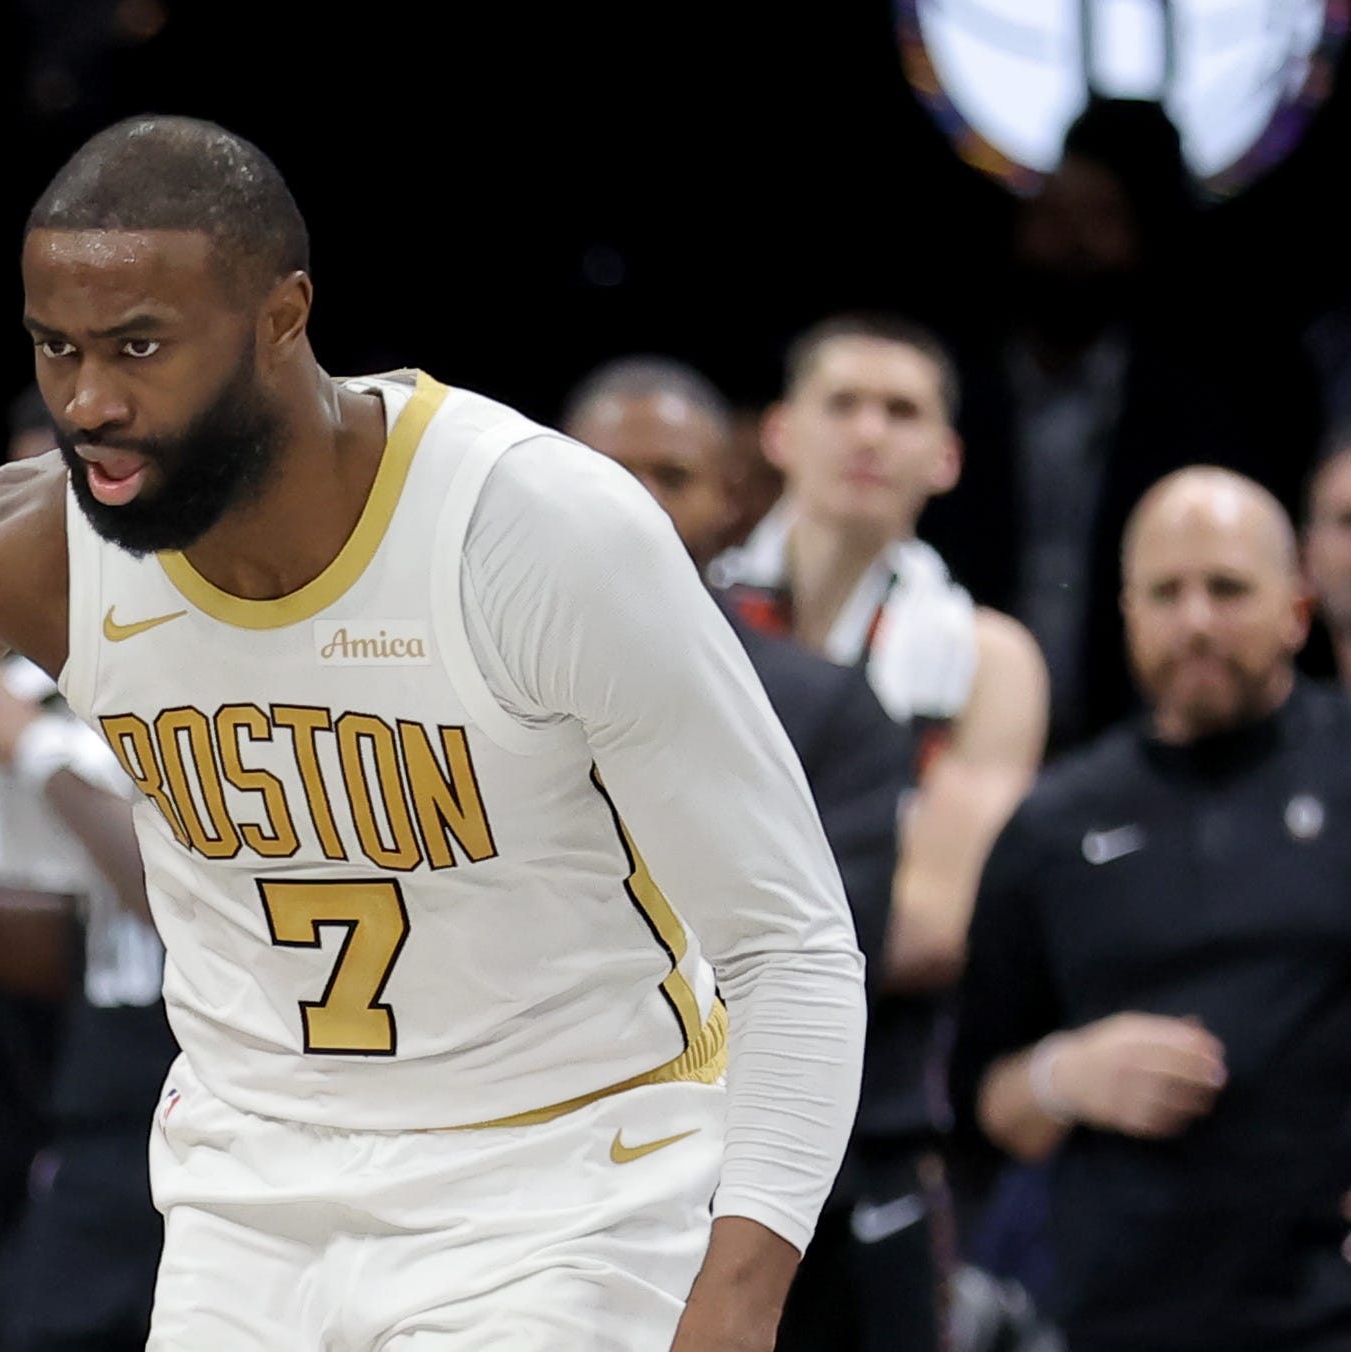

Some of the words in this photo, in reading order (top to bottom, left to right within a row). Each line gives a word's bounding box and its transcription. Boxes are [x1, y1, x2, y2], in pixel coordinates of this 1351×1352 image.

[320, 628, 426, 660] Amica
[98, 702, 499, 872] BOSTON
[254, 877, 411, 1056] 7
